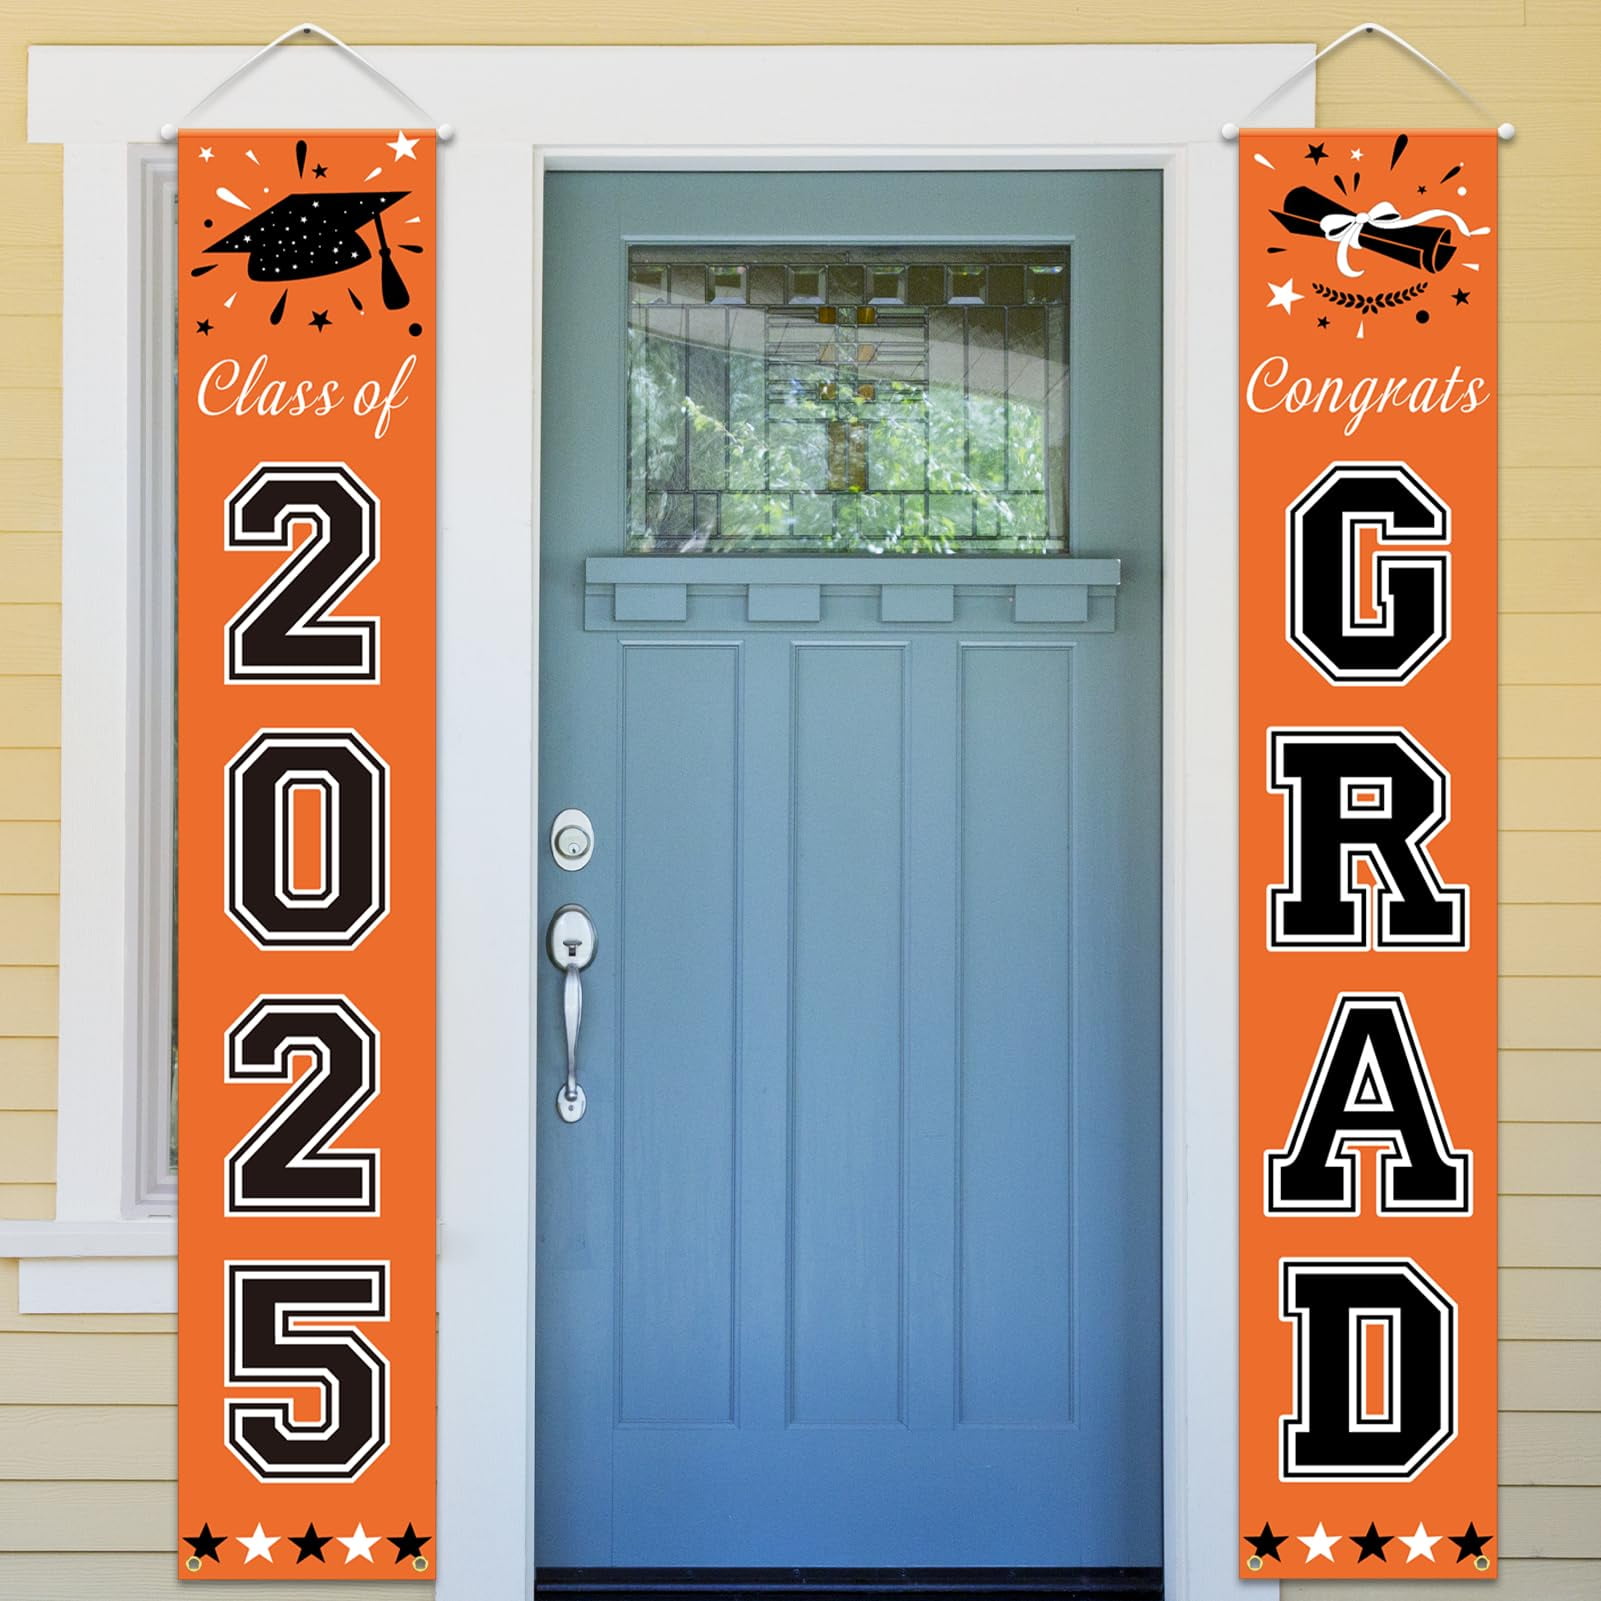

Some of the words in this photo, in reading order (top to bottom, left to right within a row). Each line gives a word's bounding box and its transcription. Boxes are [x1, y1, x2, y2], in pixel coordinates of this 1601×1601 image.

[198, 354, 344, 416] Class
[354, 354, 416, 439] of
[1246, 356, 1490, 436] Congrats
[224, 461, 391, 1483] 2025
[1263, 461, 1474, 1483] GRAD
